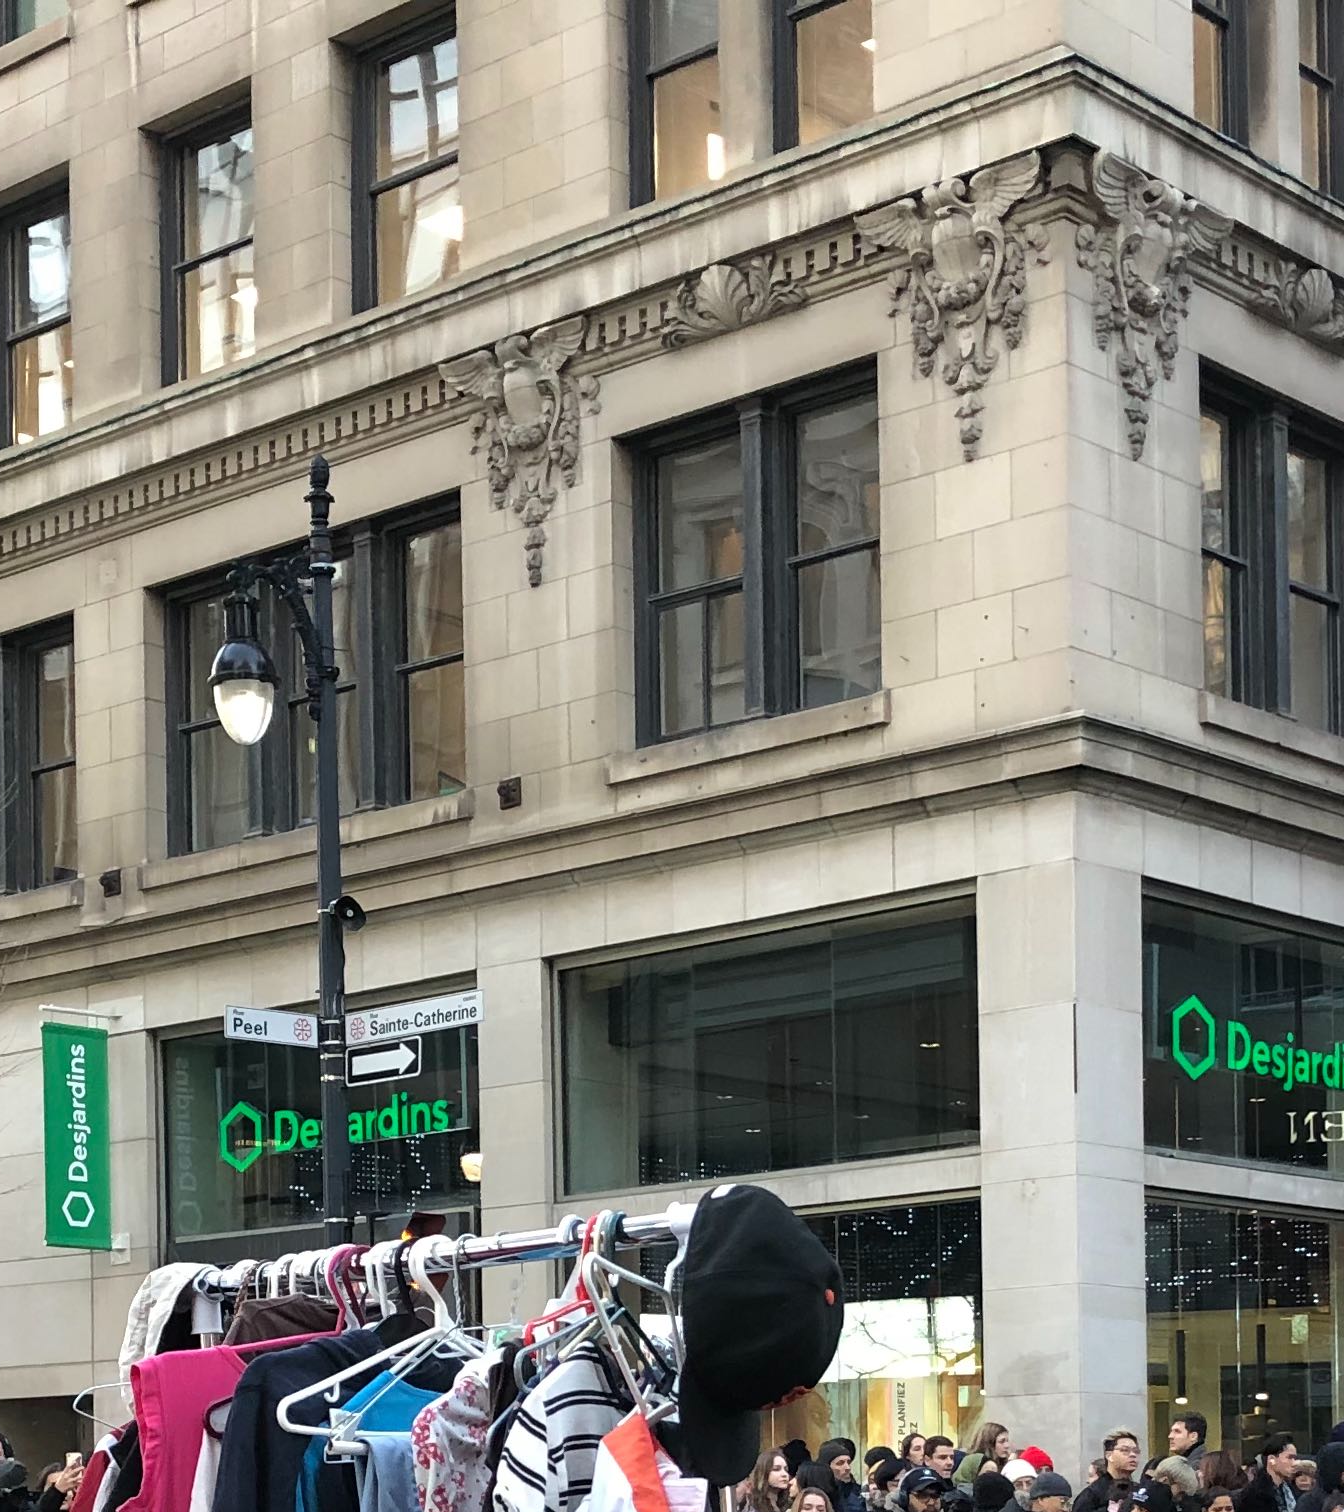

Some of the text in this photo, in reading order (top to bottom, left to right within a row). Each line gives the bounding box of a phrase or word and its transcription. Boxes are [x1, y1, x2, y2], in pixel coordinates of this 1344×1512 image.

[232, 1017, 268, 1036] Peel
[369, 1003, 478, 1036] Sainte-Catherine
[65, 1043, 91, 1182] Desjardins
[273, 1091, 450, 1152] Deardins
[897, 1382, 906, 1436] PLANIFIEZ
